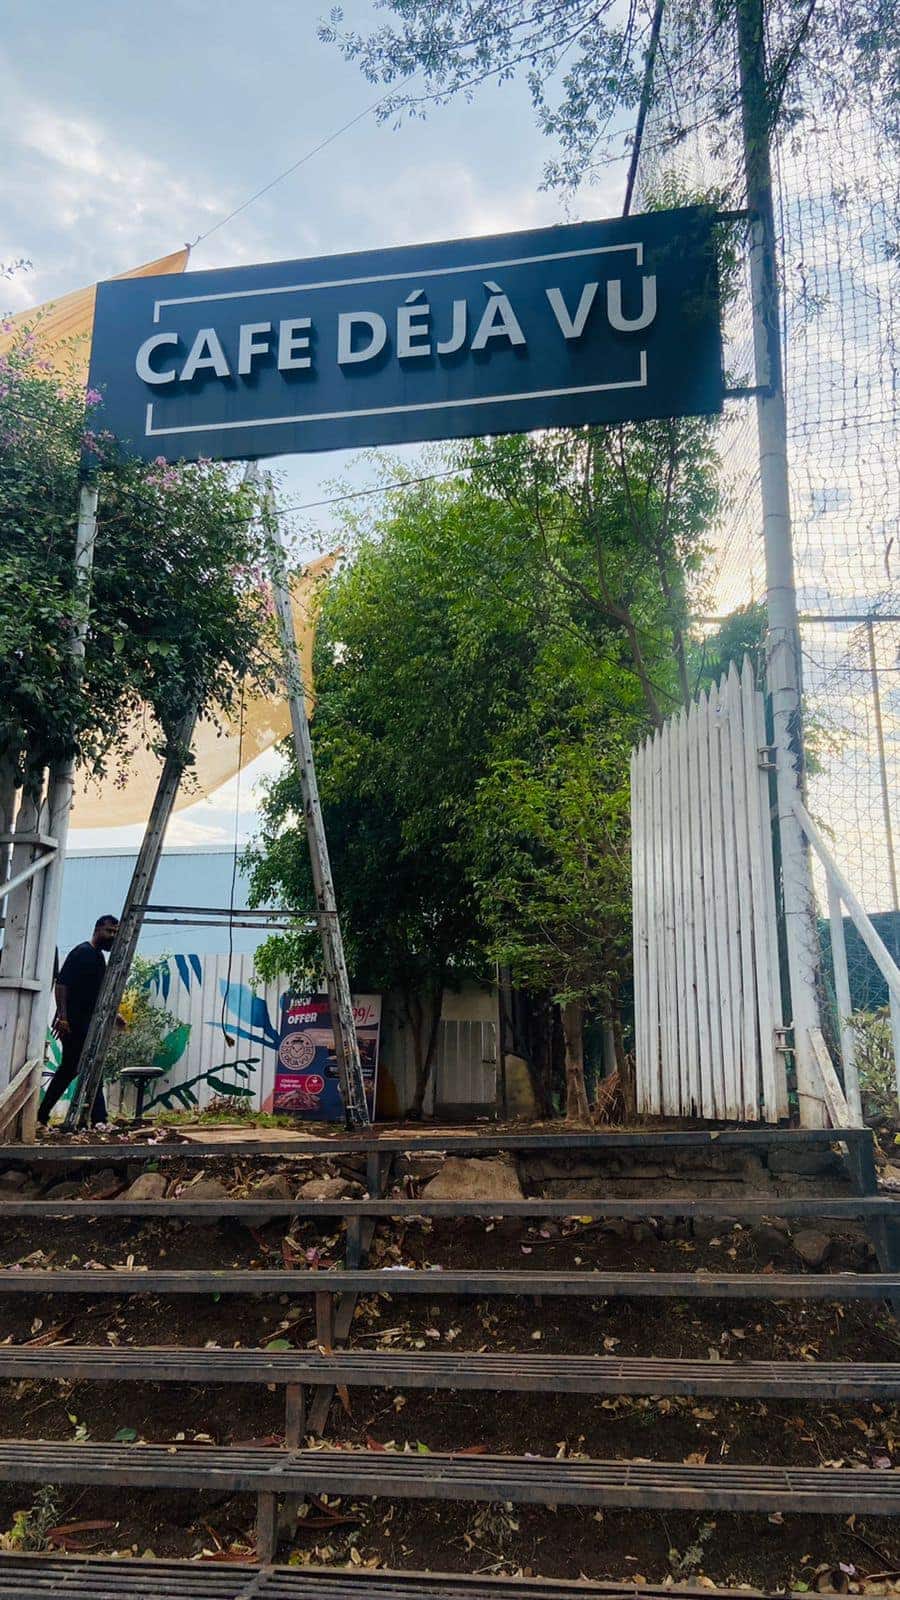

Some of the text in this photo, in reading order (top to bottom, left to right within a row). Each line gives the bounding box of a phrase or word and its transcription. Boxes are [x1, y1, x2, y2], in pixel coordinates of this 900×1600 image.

[135, 274, 658, 386] CAFE DÉJÀ VU
